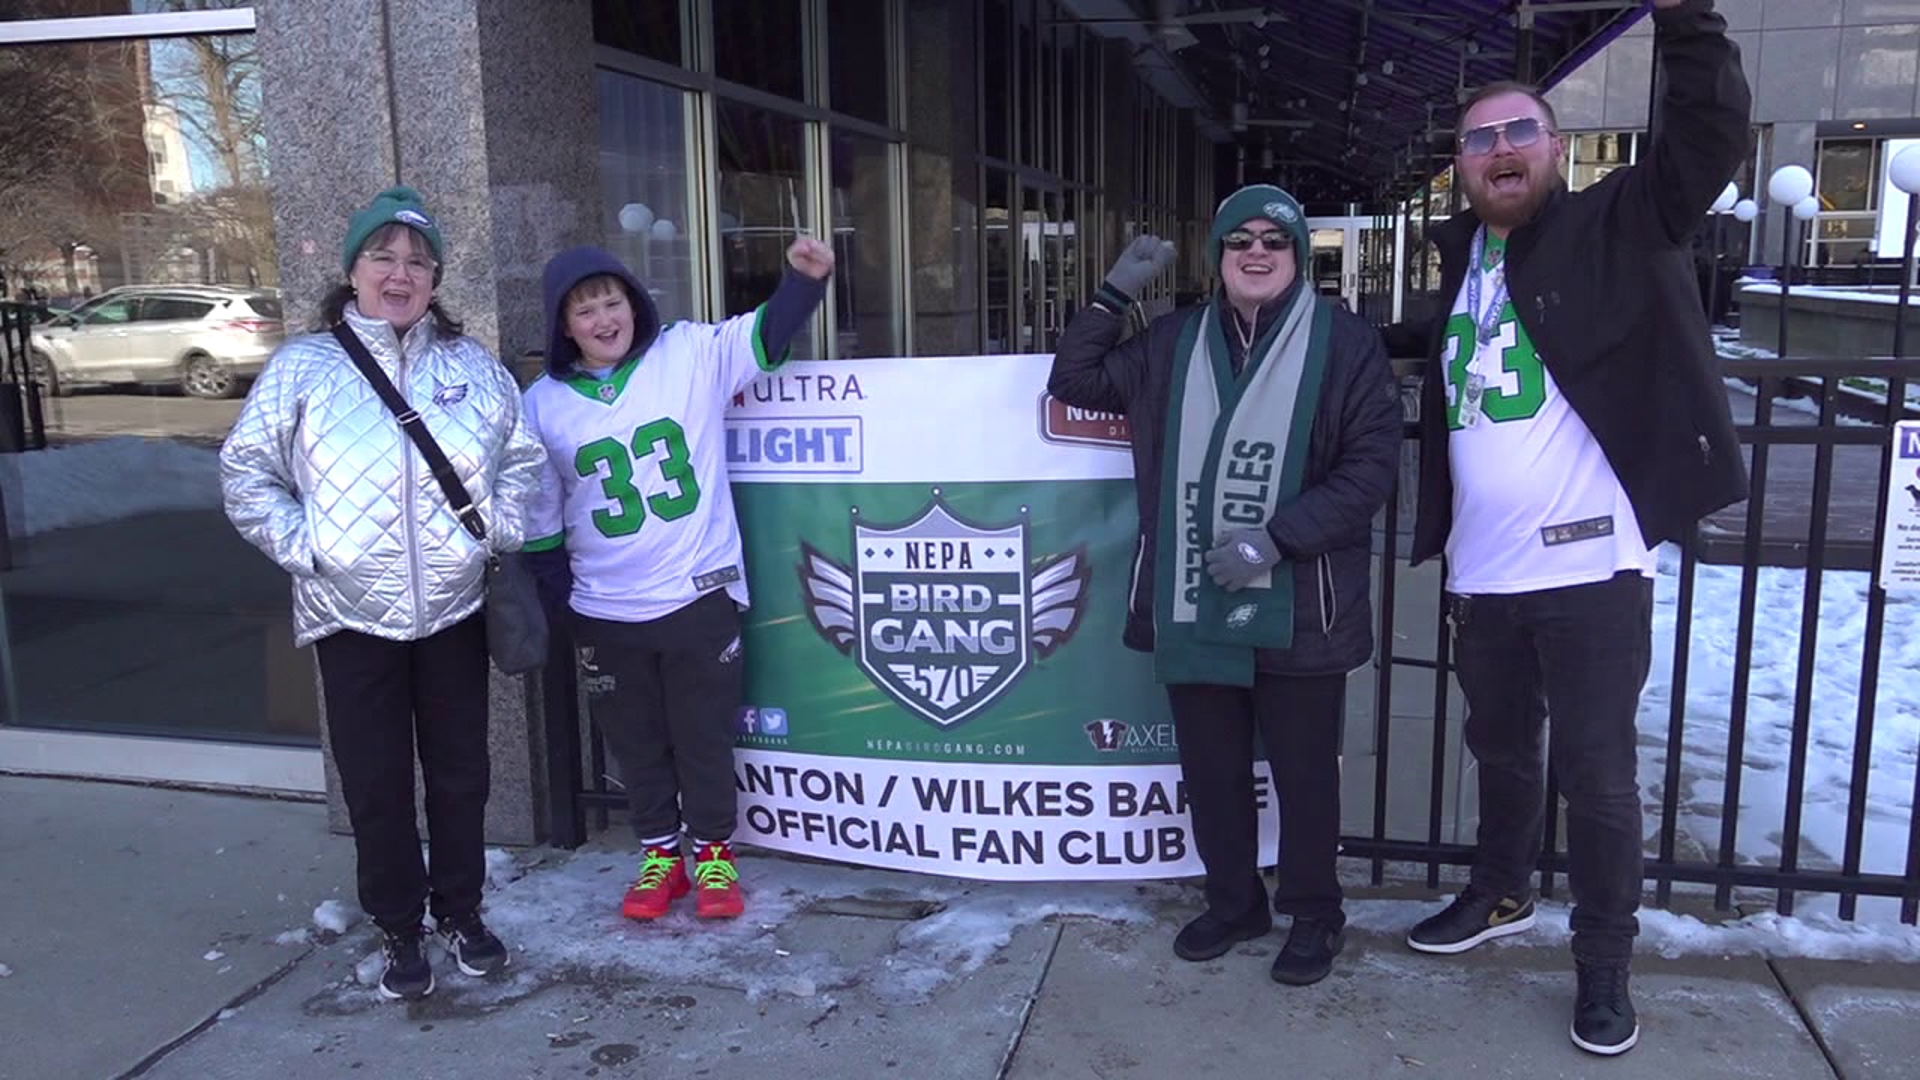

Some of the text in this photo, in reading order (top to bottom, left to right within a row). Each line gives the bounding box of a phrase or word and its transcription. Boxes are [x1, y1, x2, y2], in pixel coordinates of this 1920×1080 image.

[754, 374, 863, 402] ULTRA
[726, 427, 853, 463] LIGHT
[574, 417, 701, 538] 33
[1222, 439, 1276, 531] GLES
[905, 541, 973, 570] NEPA
[890, 583, 992, 613] BIRD
[870, 618, 1016, 655] GANG
[914, 666, 974, 702] 570
[912, 776, 1095, 817] WILKES
[746, 804, 1186, 865] OFFICIAL FAN CLUB
